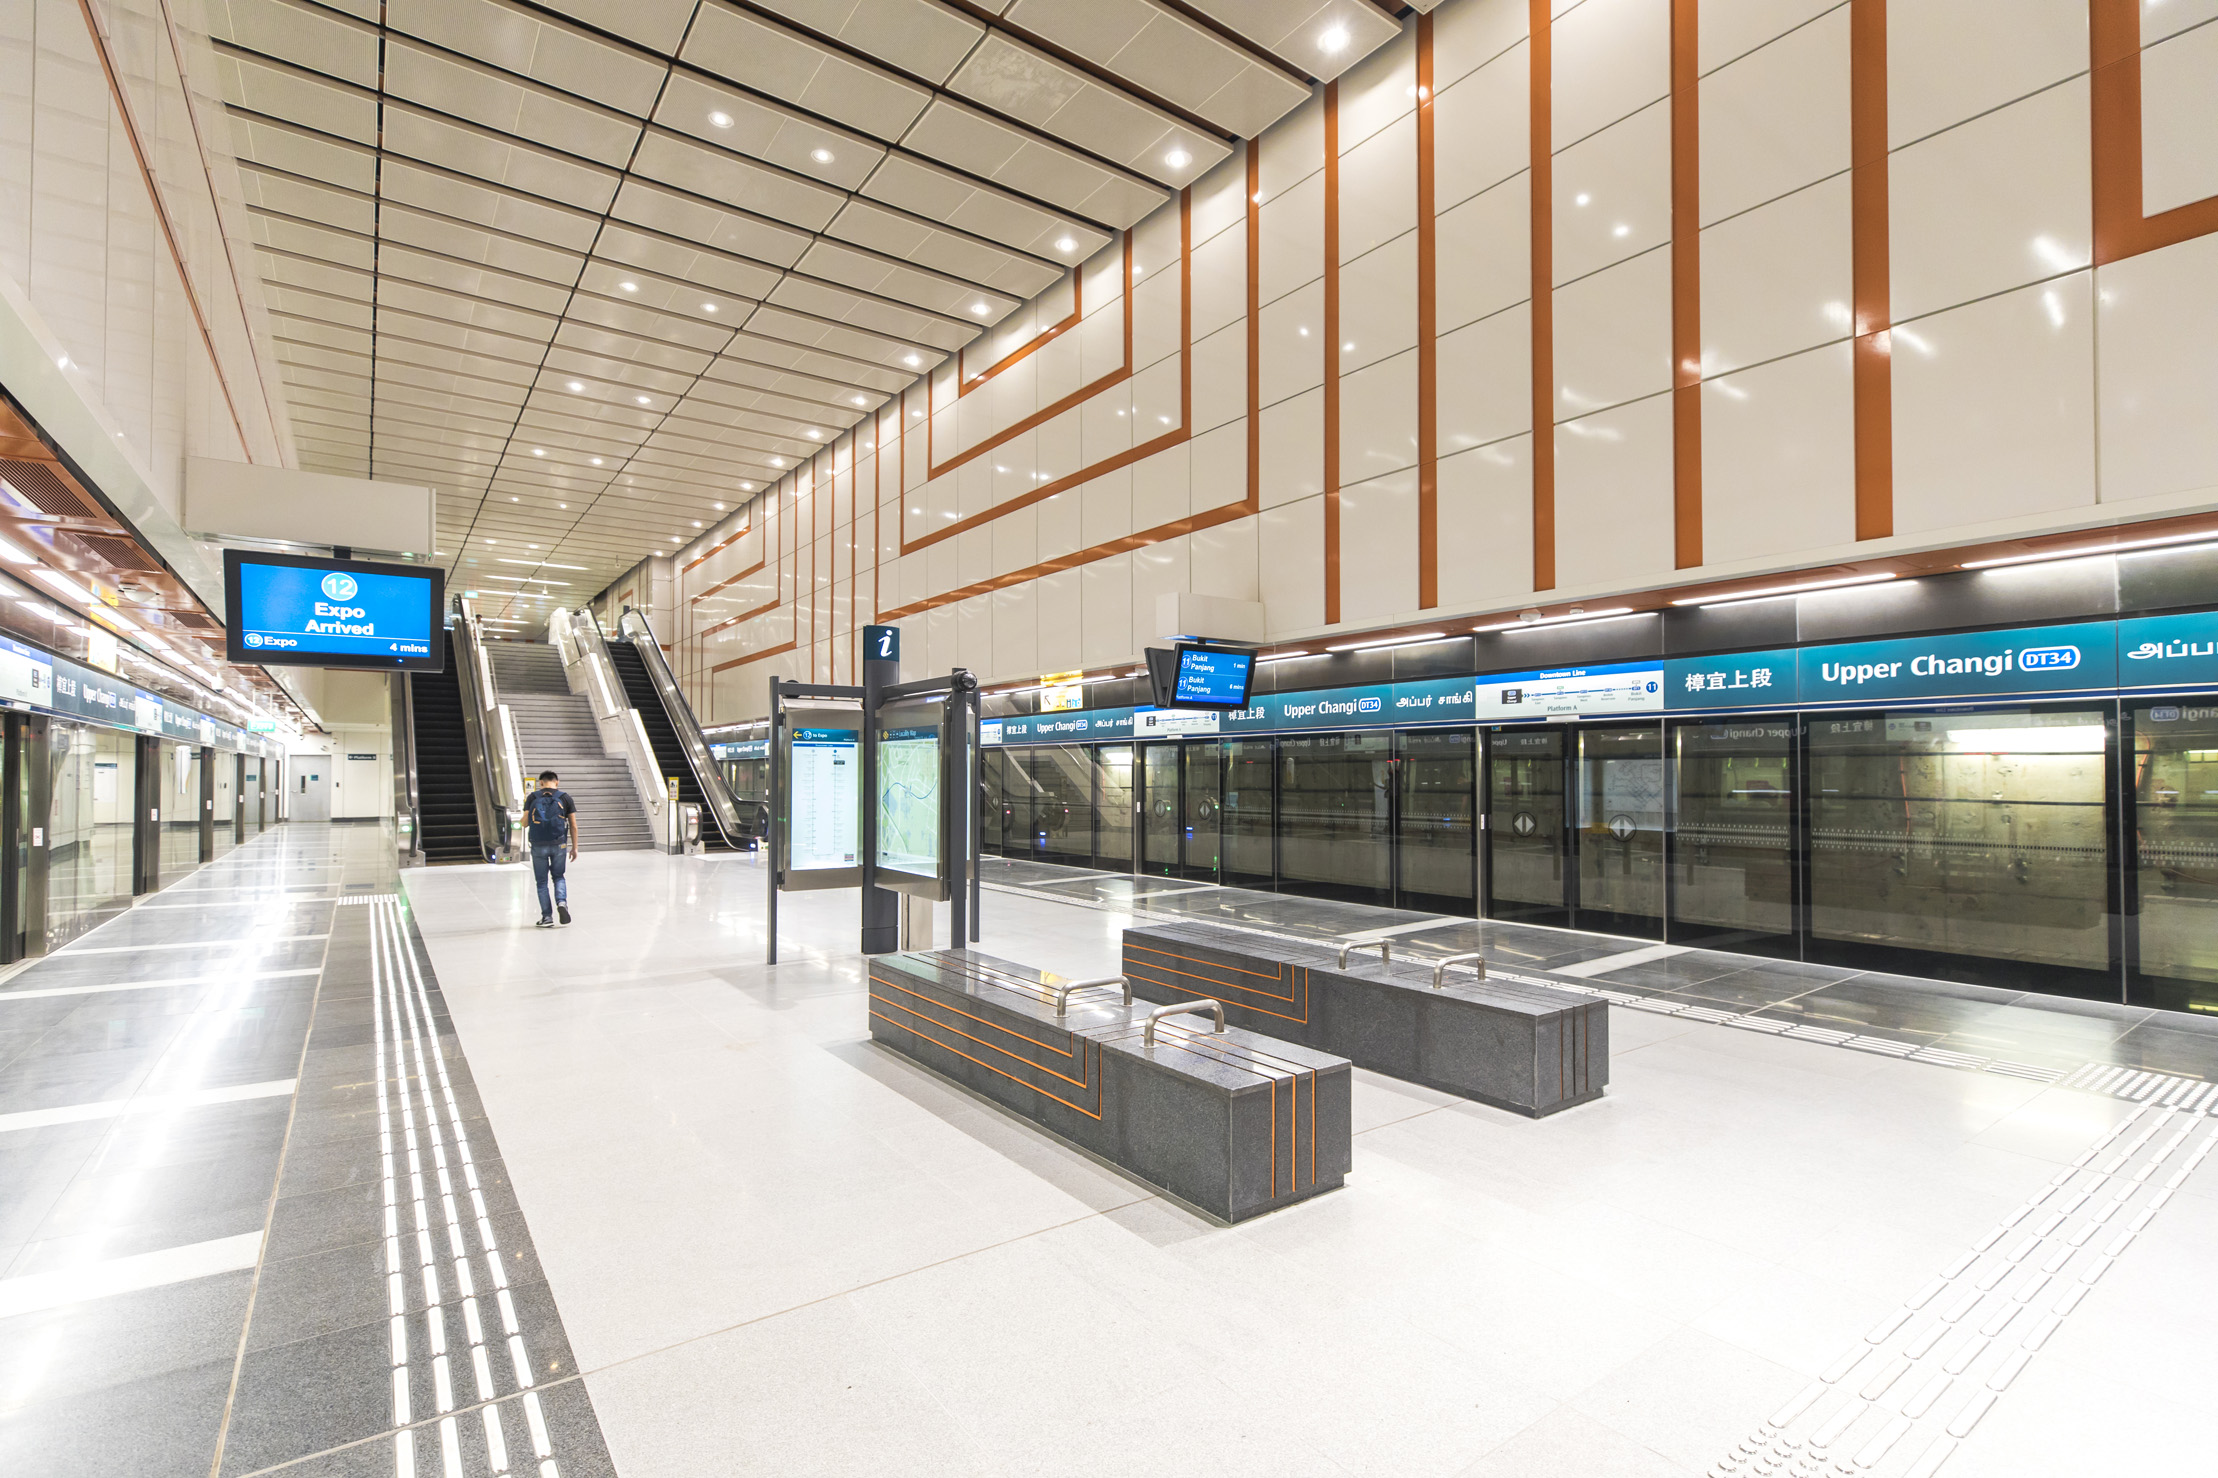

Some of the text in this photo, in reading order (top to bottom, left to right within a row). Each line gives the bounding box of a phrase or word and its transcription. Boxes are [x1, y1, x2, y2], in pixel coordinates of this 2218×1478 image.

[326, 578, 354, 596] 12
[314, 602, 366, 620] Expo
[305, 619, 374, 636] Arrived
[247, 635, 428, 653] 12 Expo 4 mins
[2127, 639, 2218, 660] அப்ப
[1192, 654, 1208, 662] Bukit
[1190, 663, 1215, 673] Panjang
[1539, 669, 1586, 680] Downtown Line
[1822, 649, 2073, 685] Upper Changi DT34
[1188, 676, 1205, 684] Bukit
[1685, 668, 1773, 692] 樟宜上段
[1187, 684, 1211, 695] Panjang
[1284, 699, 1379, 719] Upper Changi DT34
[1037, 723, 1054, 734] Upper
[1055, 721, 1076, 732] Changi
